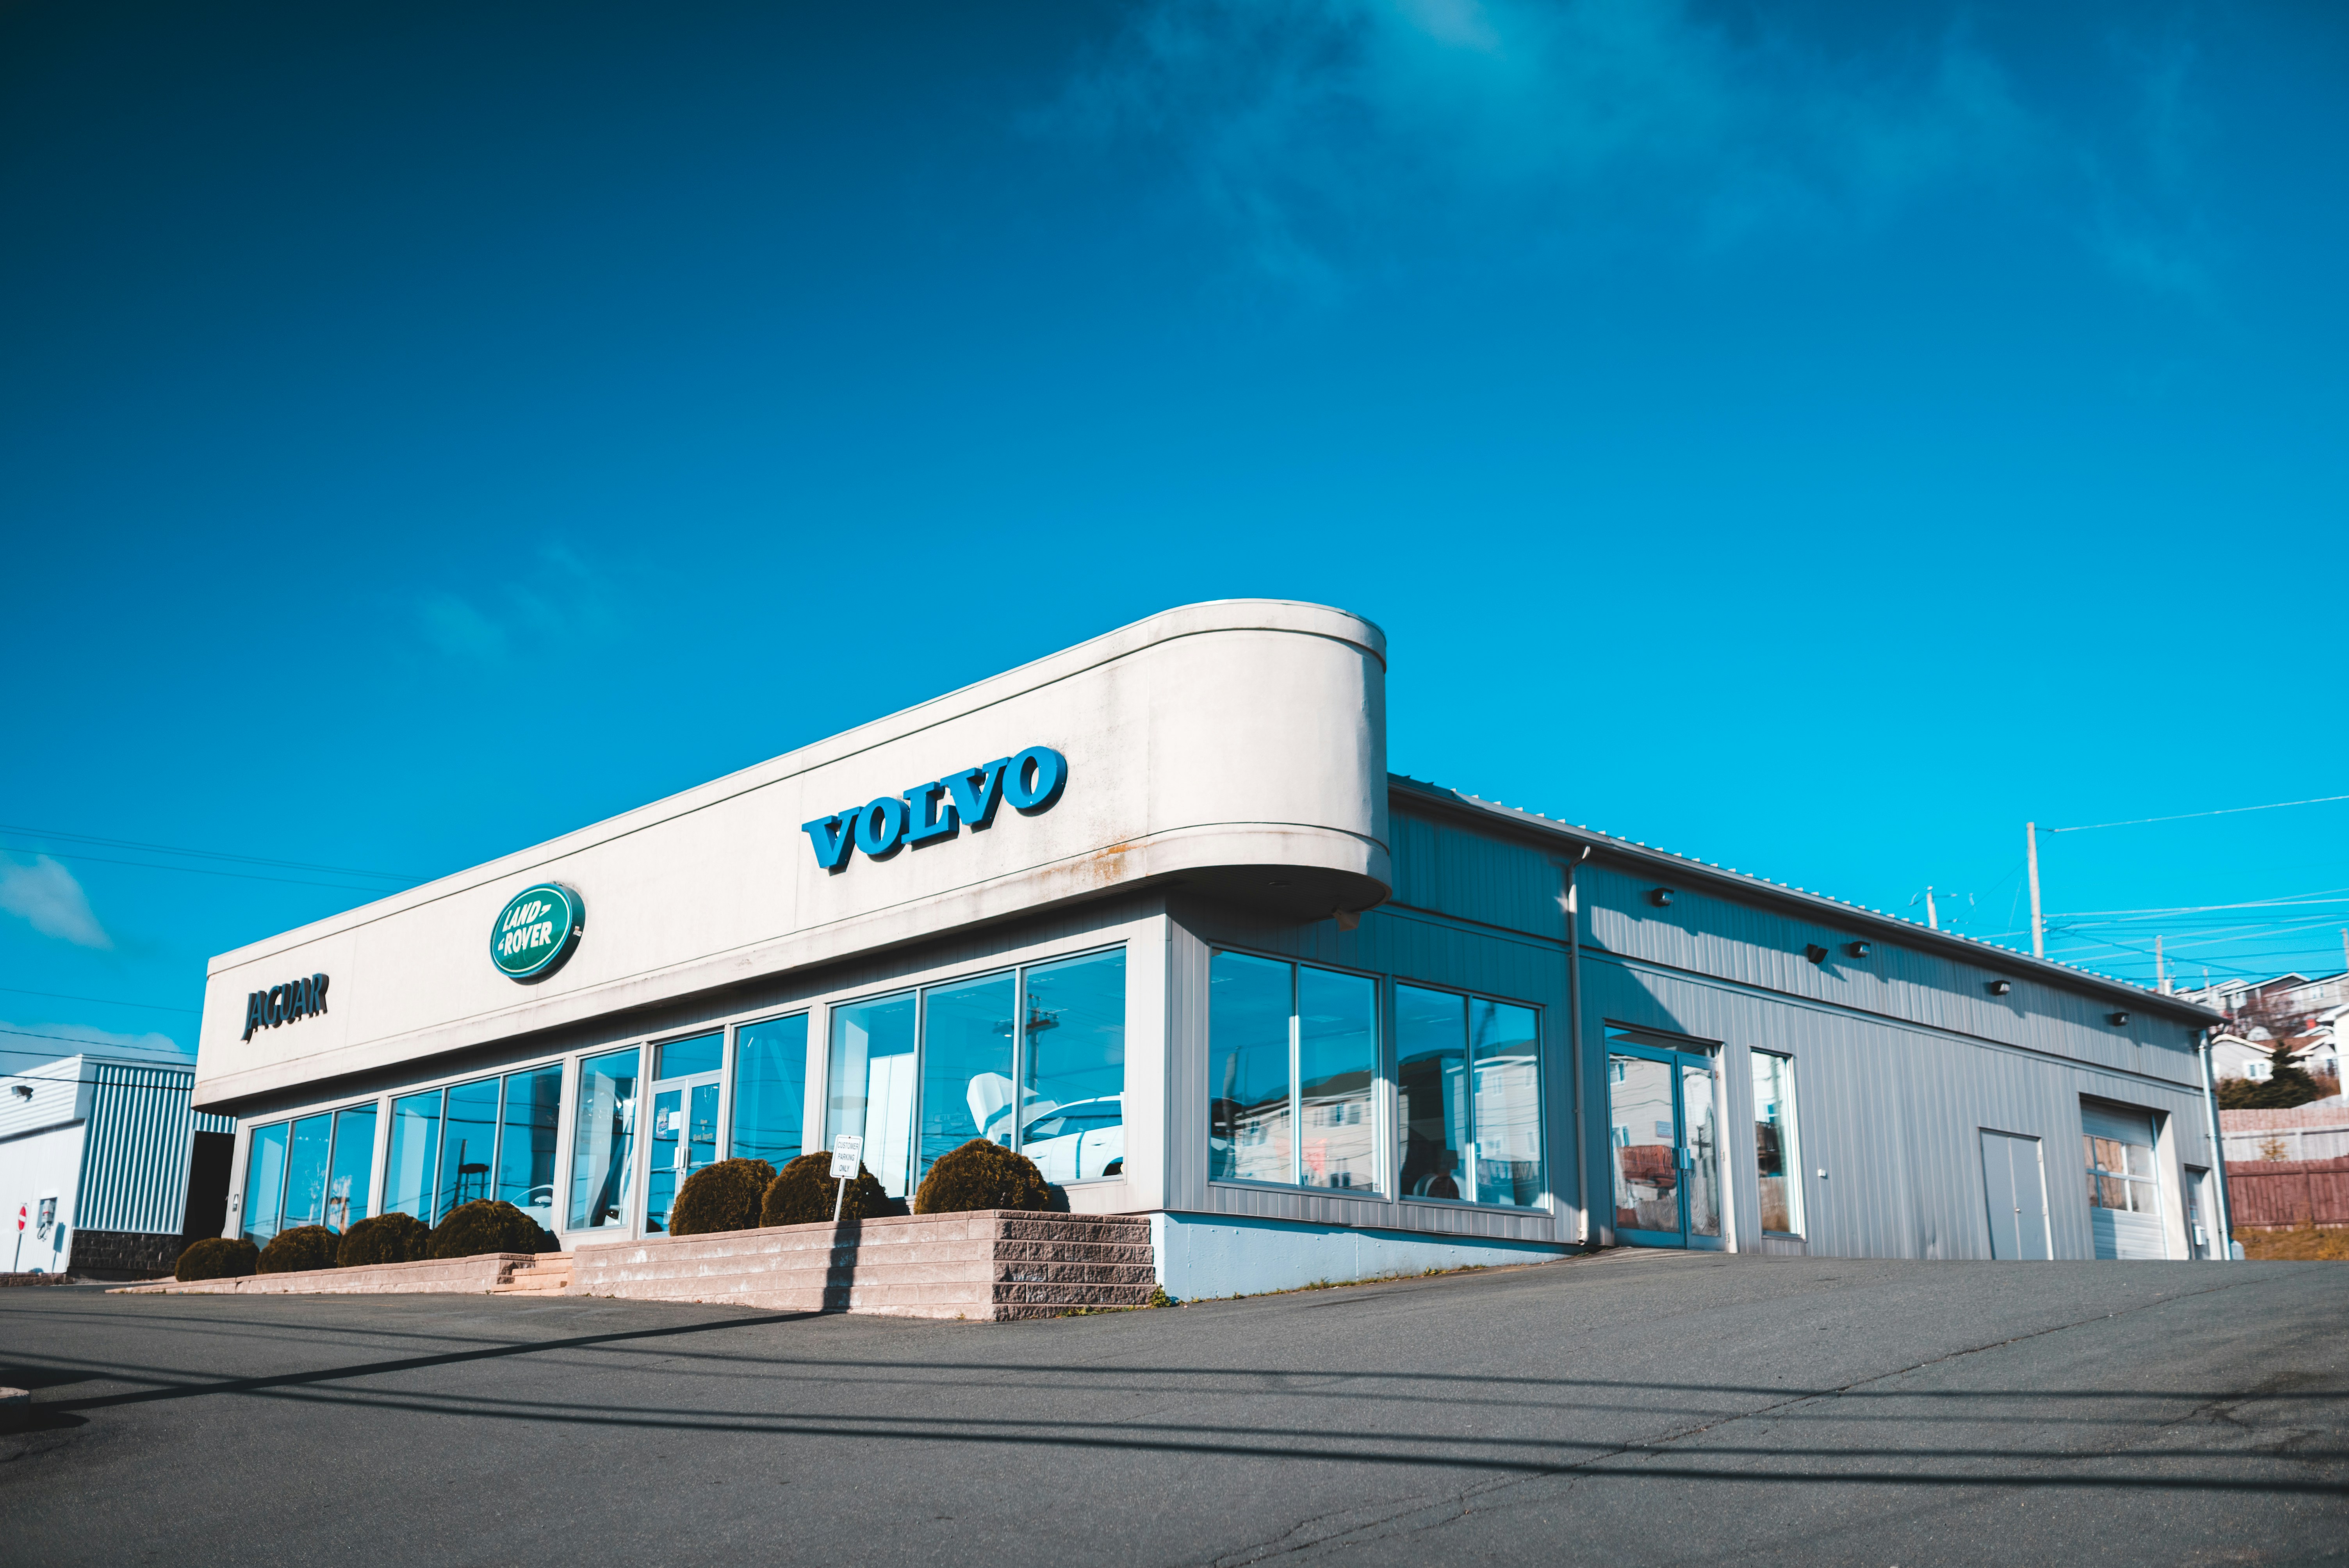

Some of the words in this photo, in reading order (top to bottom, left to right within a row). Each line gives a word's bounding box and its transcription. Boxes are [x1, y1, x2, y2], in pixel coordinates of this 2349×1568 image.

[802, 746, 1067, 876] VOLVO
[502, 900, 542, 932] LAND
[504, 921, 552, 956] ROVER
[240, 973, 329, 1044] JAGUAR
[837, 1141, 859, 1150] CUSTOMER
